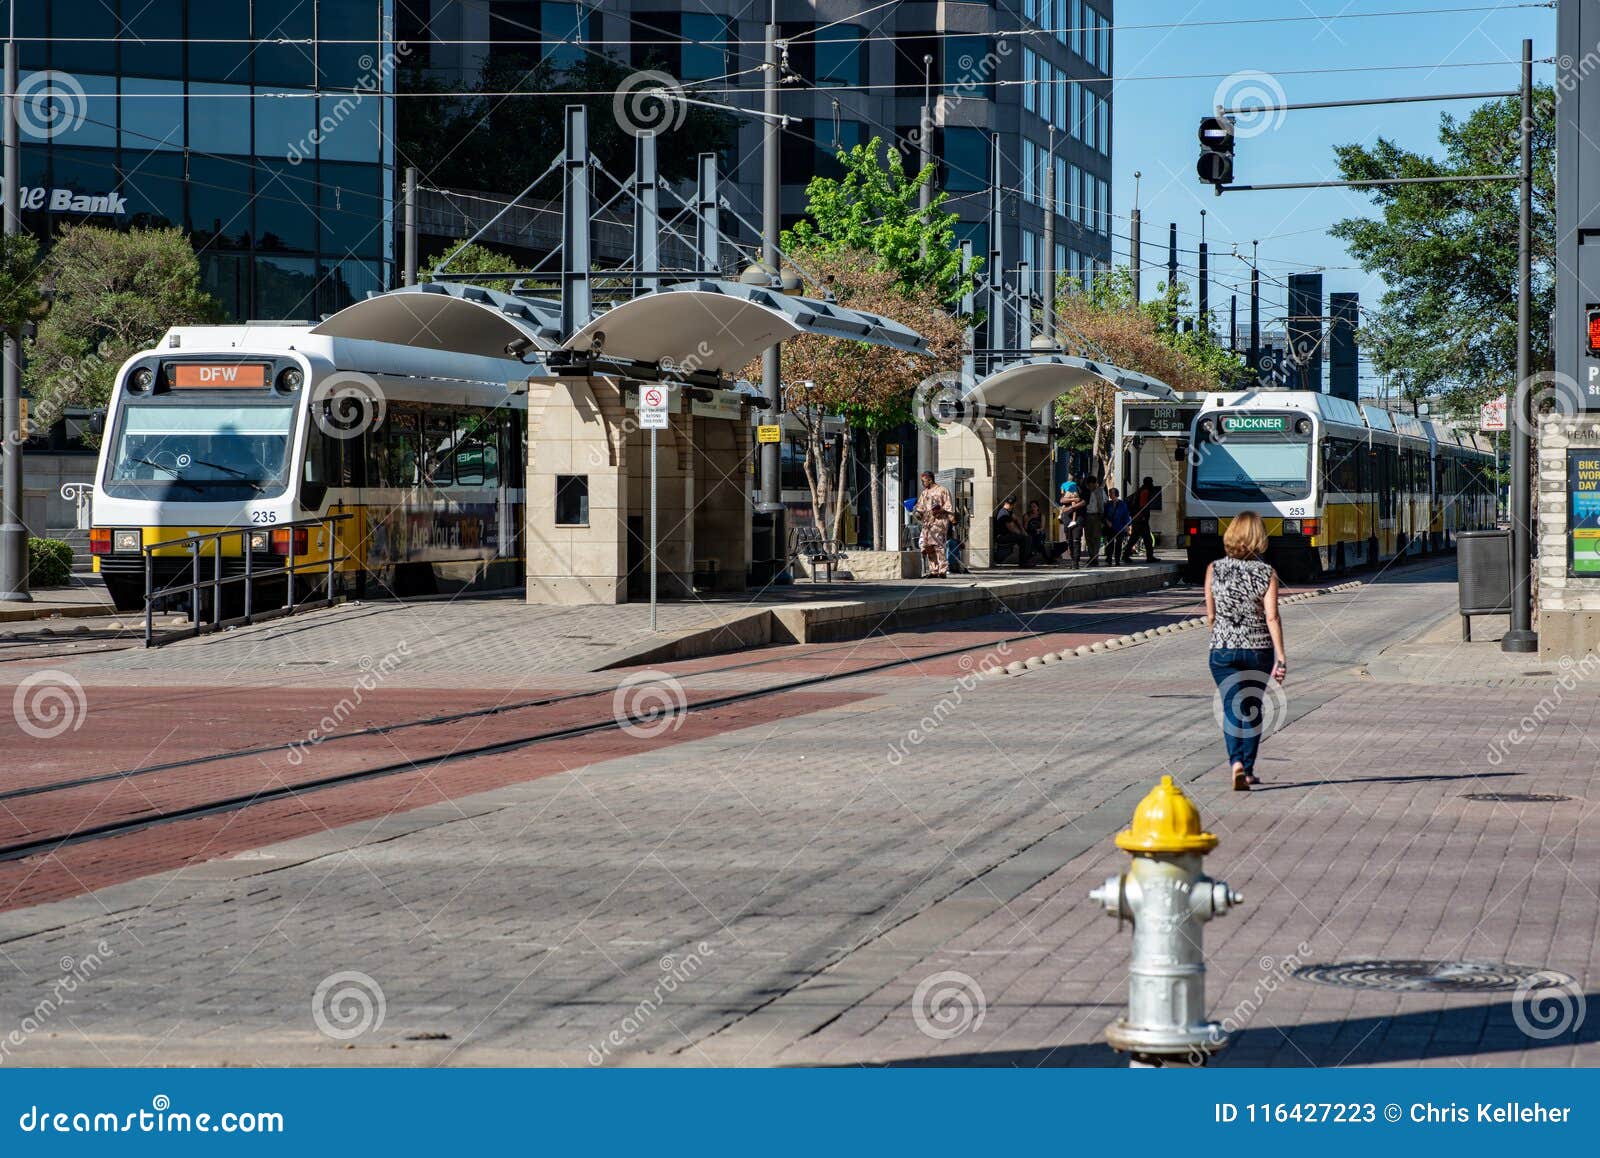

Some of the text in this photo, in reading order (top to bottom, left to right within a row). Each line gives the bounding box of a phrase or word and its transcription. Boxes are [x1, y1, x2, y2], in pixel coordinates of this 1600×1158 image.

[49, 189, 127, 214] Bank
[200, 367, 238, 381] DFW
[1154, 408, 1177, 418] DART
[1229, 418, 1282, 428] BUCKNER
[1578, 461, 1600, 470] BIKE
[1578, 482, 1597, 490] DAY
[1289, 507, 1305, 516] 253
[252, 511, 277, 523] 235
[412, 519, 429, 549] Are
[432, 520, 448, 549] You
[450, 520, 460, 549] at
